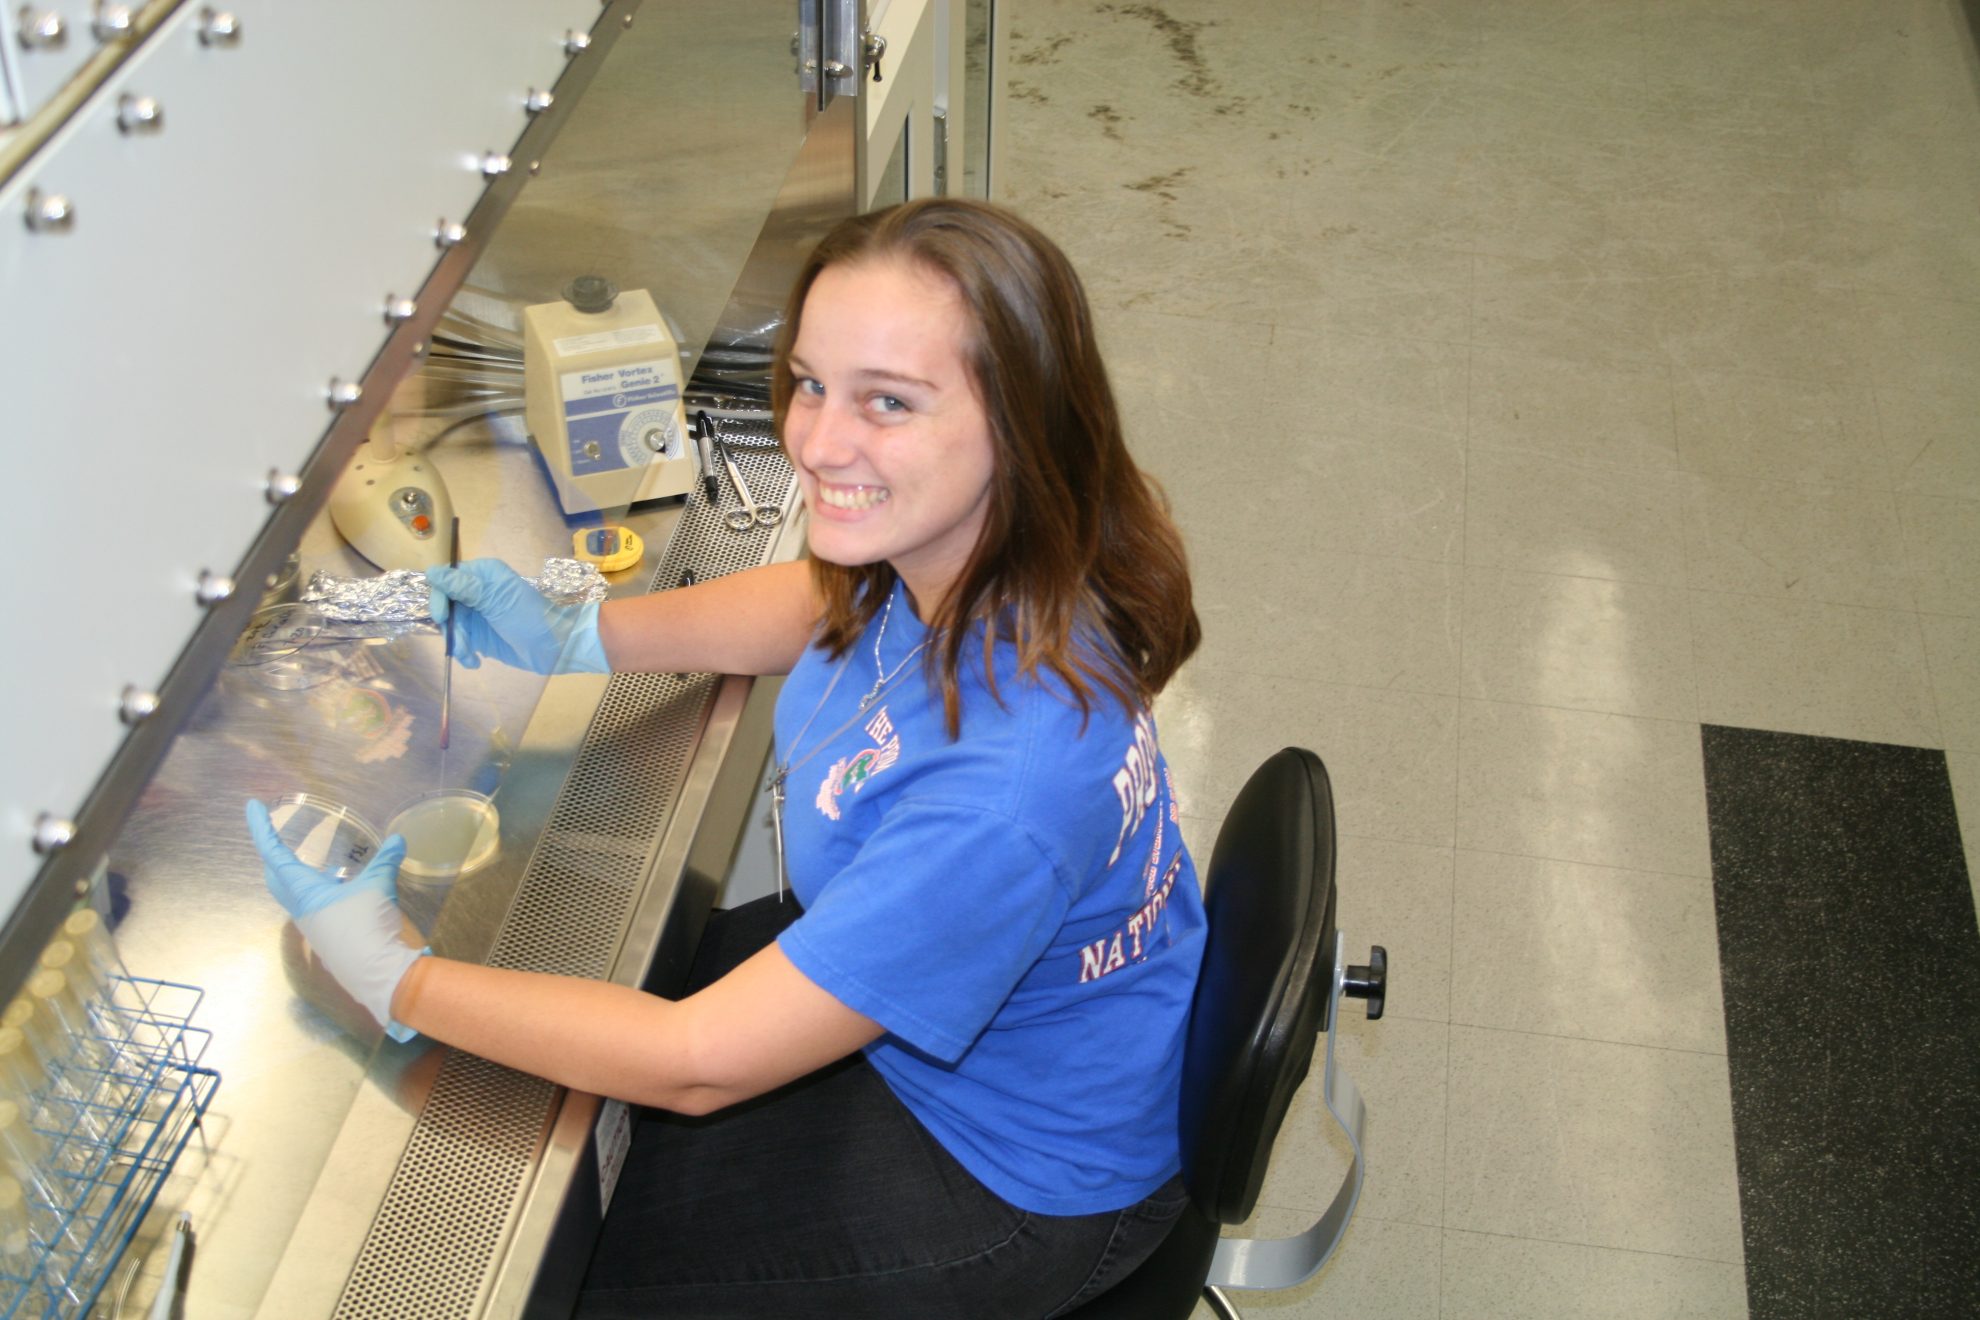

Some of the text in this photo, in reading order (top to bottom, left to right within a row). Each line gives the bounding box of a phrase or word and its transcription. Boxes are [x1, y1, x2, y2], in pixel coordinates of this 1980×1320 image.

[581, 366, 653, 384] Fisher Vortex
[620, 375, 660, 389] Genie 2
